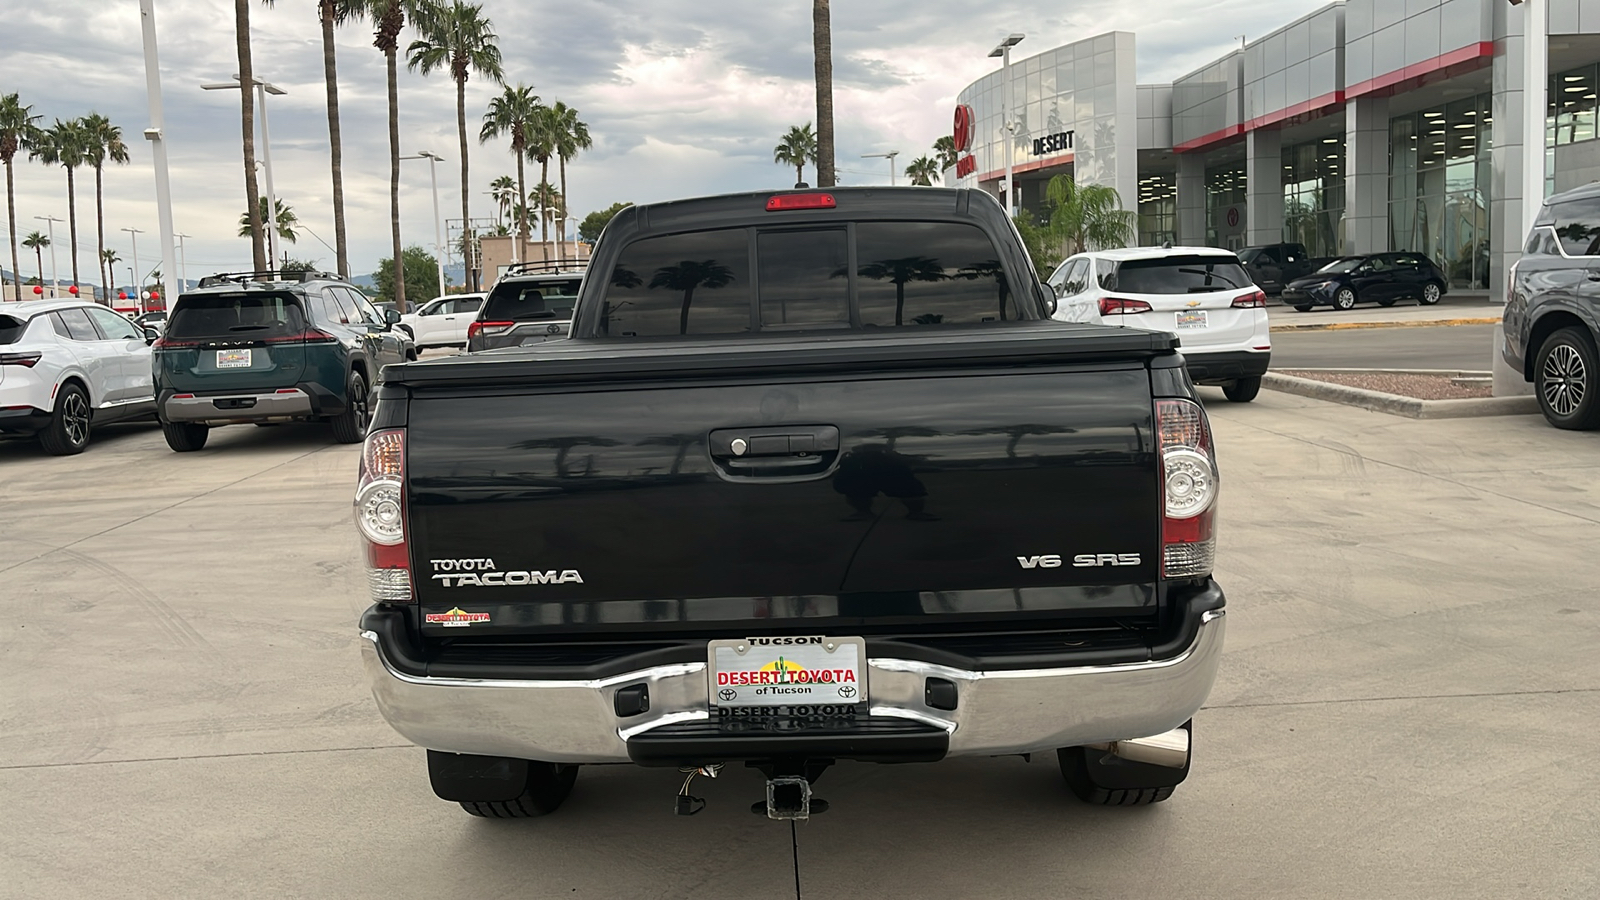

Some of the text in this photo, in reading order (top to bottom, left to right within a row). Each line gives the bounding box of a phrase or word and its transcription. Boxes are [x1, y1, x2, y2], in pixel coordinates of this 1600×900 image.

[1033, 130, 1075, 156] DESERT
[430, 558, 496, 571] TOYOTA
[1016, 552, 1142, 569] V6 SR5
[431, 570, 584, 587] TACOMA
[427, 614, 455, 622] DESERT
[748, 636, 823, 646] TUCSON
[717, 669, 856, 686] DESERT TOYOTA
[755, 686, 812, 695] of Tucson
[718, 705, 857, 718] DESERT TOYOTA
